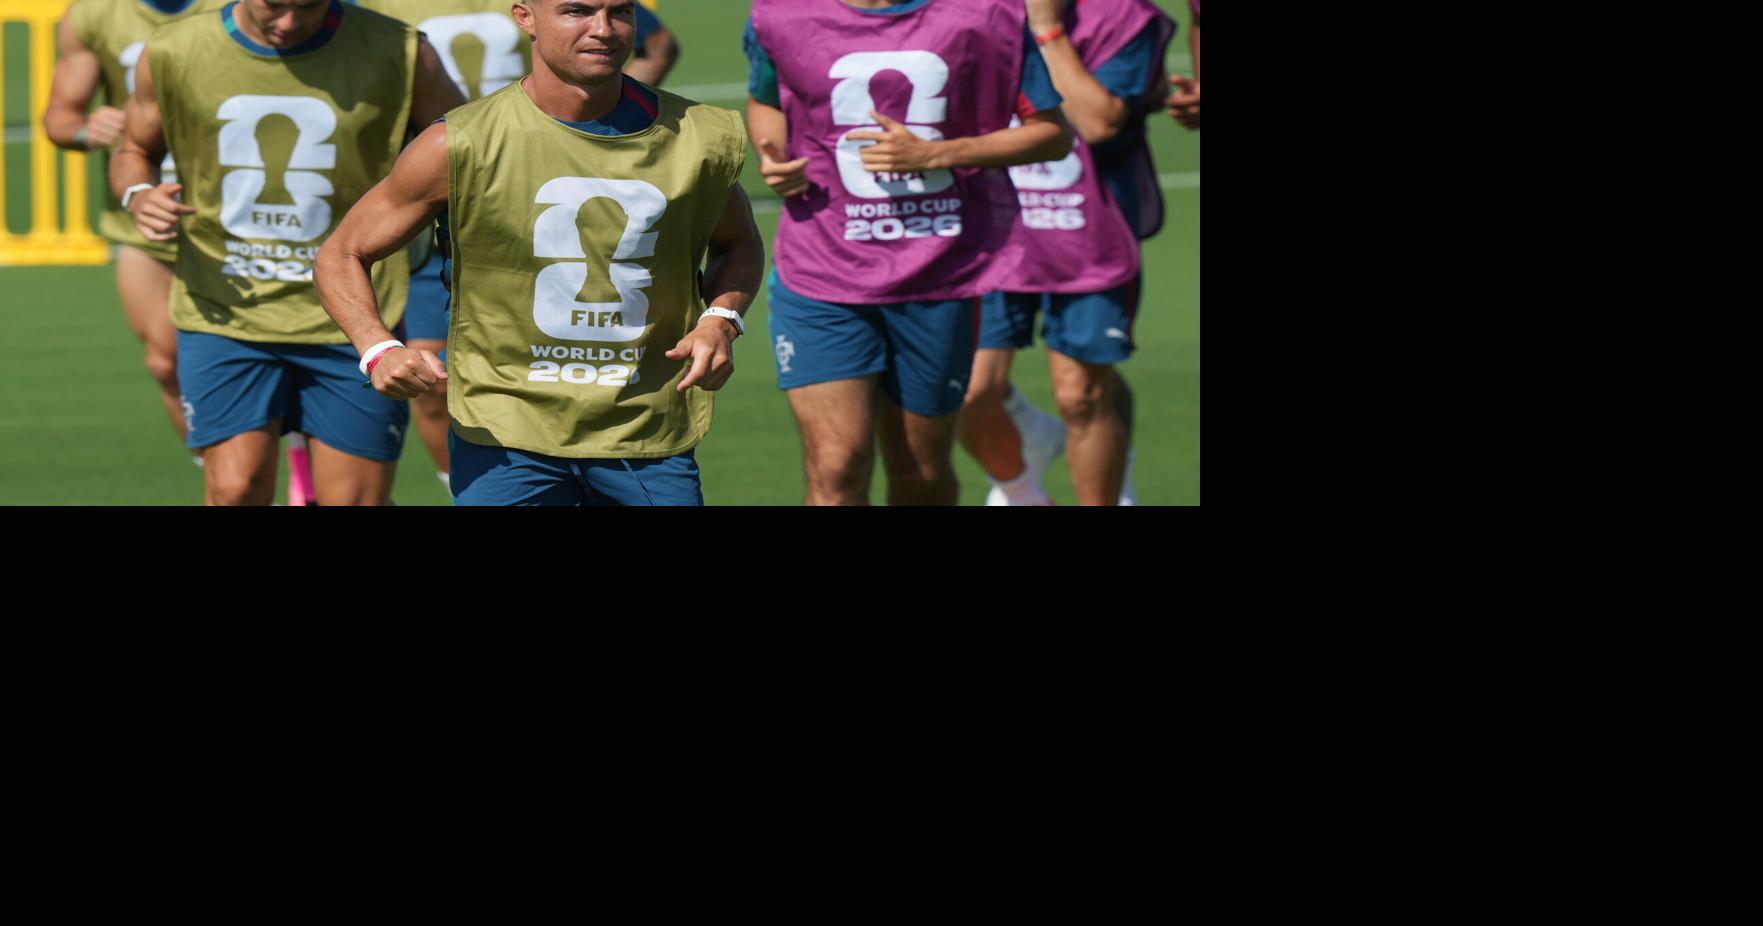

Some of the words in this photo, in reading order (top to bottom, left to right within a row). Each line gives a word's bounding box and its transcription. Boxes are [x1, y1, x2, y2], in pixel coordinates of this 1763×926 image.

[845, 201, 918, 218] WORLD
[920, 198, 962, 214] CUP
[252, 210, 303, 228] FIFA
[843, 214, 963, 241] 2026
[1021, 207, 1086, 230] 26
[224, 240, 292, 259] WORLD
[294, 245, 320, 259] CU
[221, 254, 313, 281] 202
[570, 309, 624, 328] FIFA
[530, 344, 616, 361] WORLD
[619, 345, 646, 362] CU
